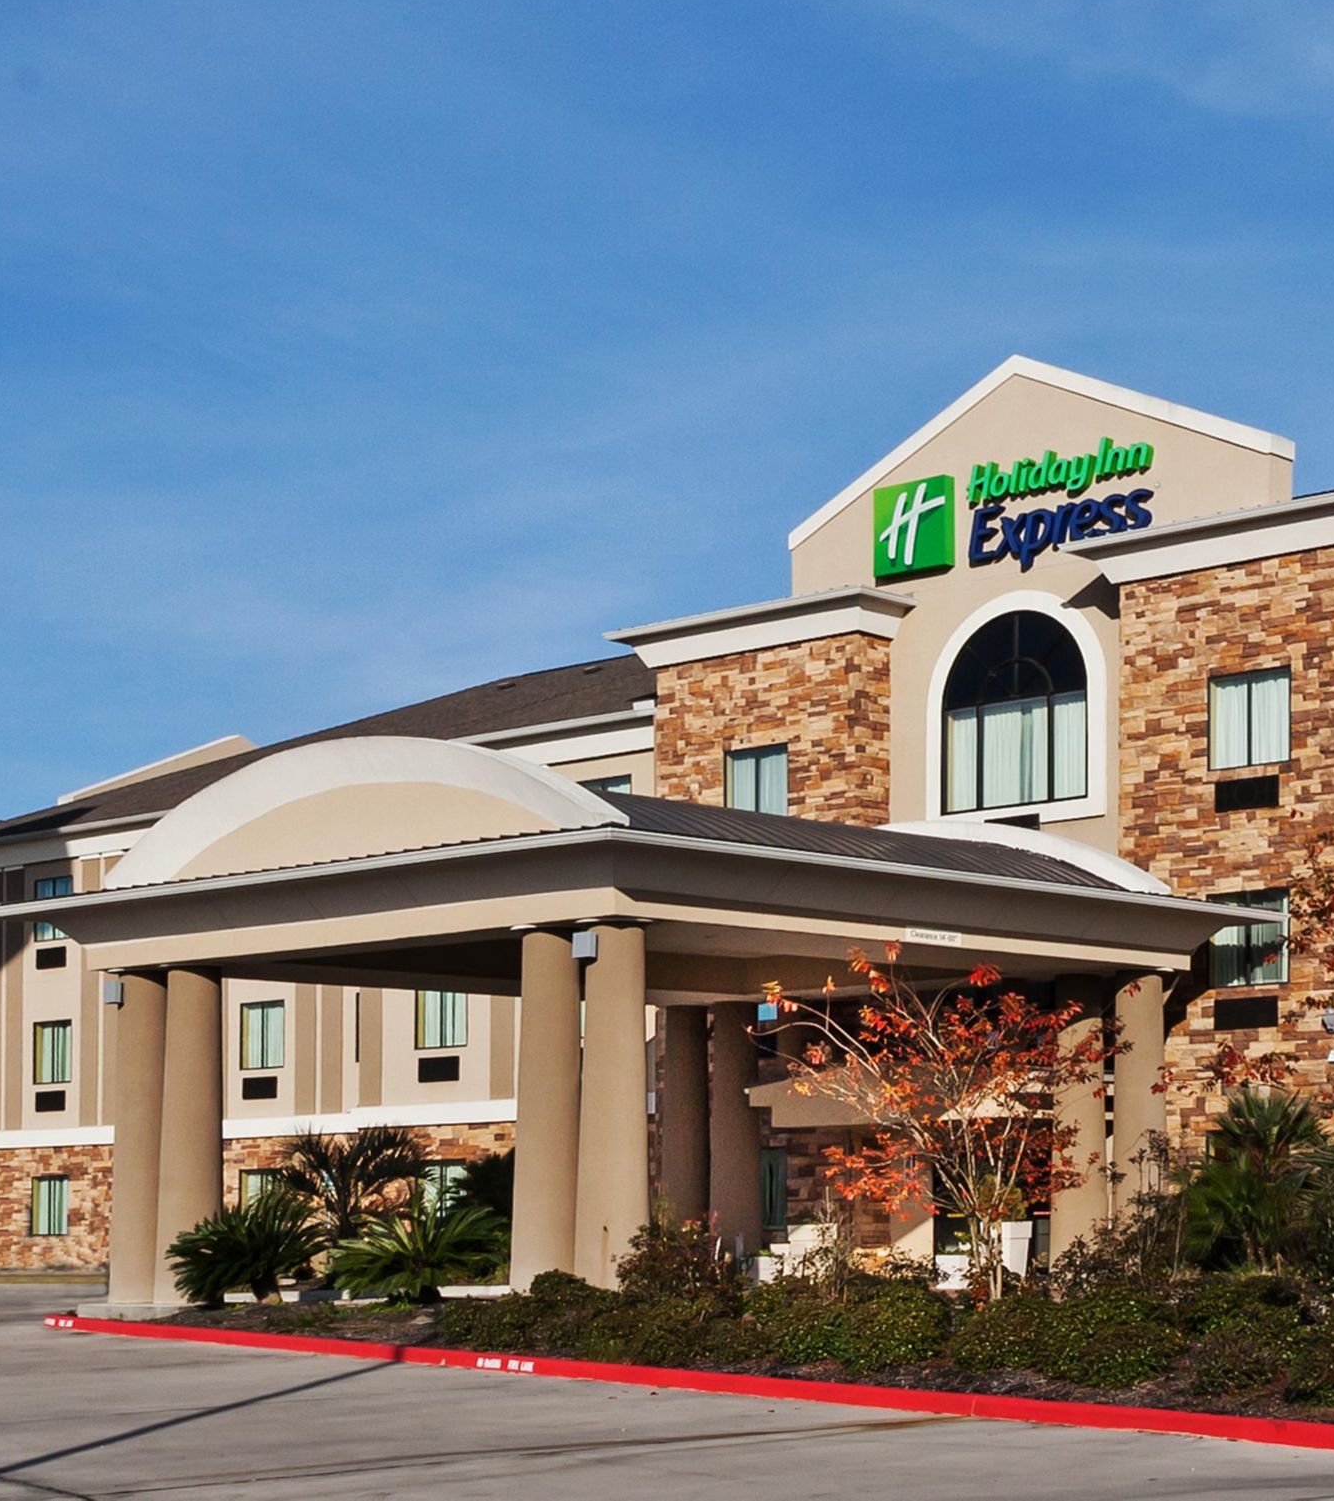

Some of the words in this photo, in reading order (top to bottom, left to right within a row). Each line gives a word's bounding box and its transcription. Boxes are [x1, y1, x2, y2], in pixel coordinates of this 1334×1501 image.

[967, 450, 1097, 504] Holiday
[1095, 436, 1154, 477] Inn
[968, 488, 1154, 572] Express
